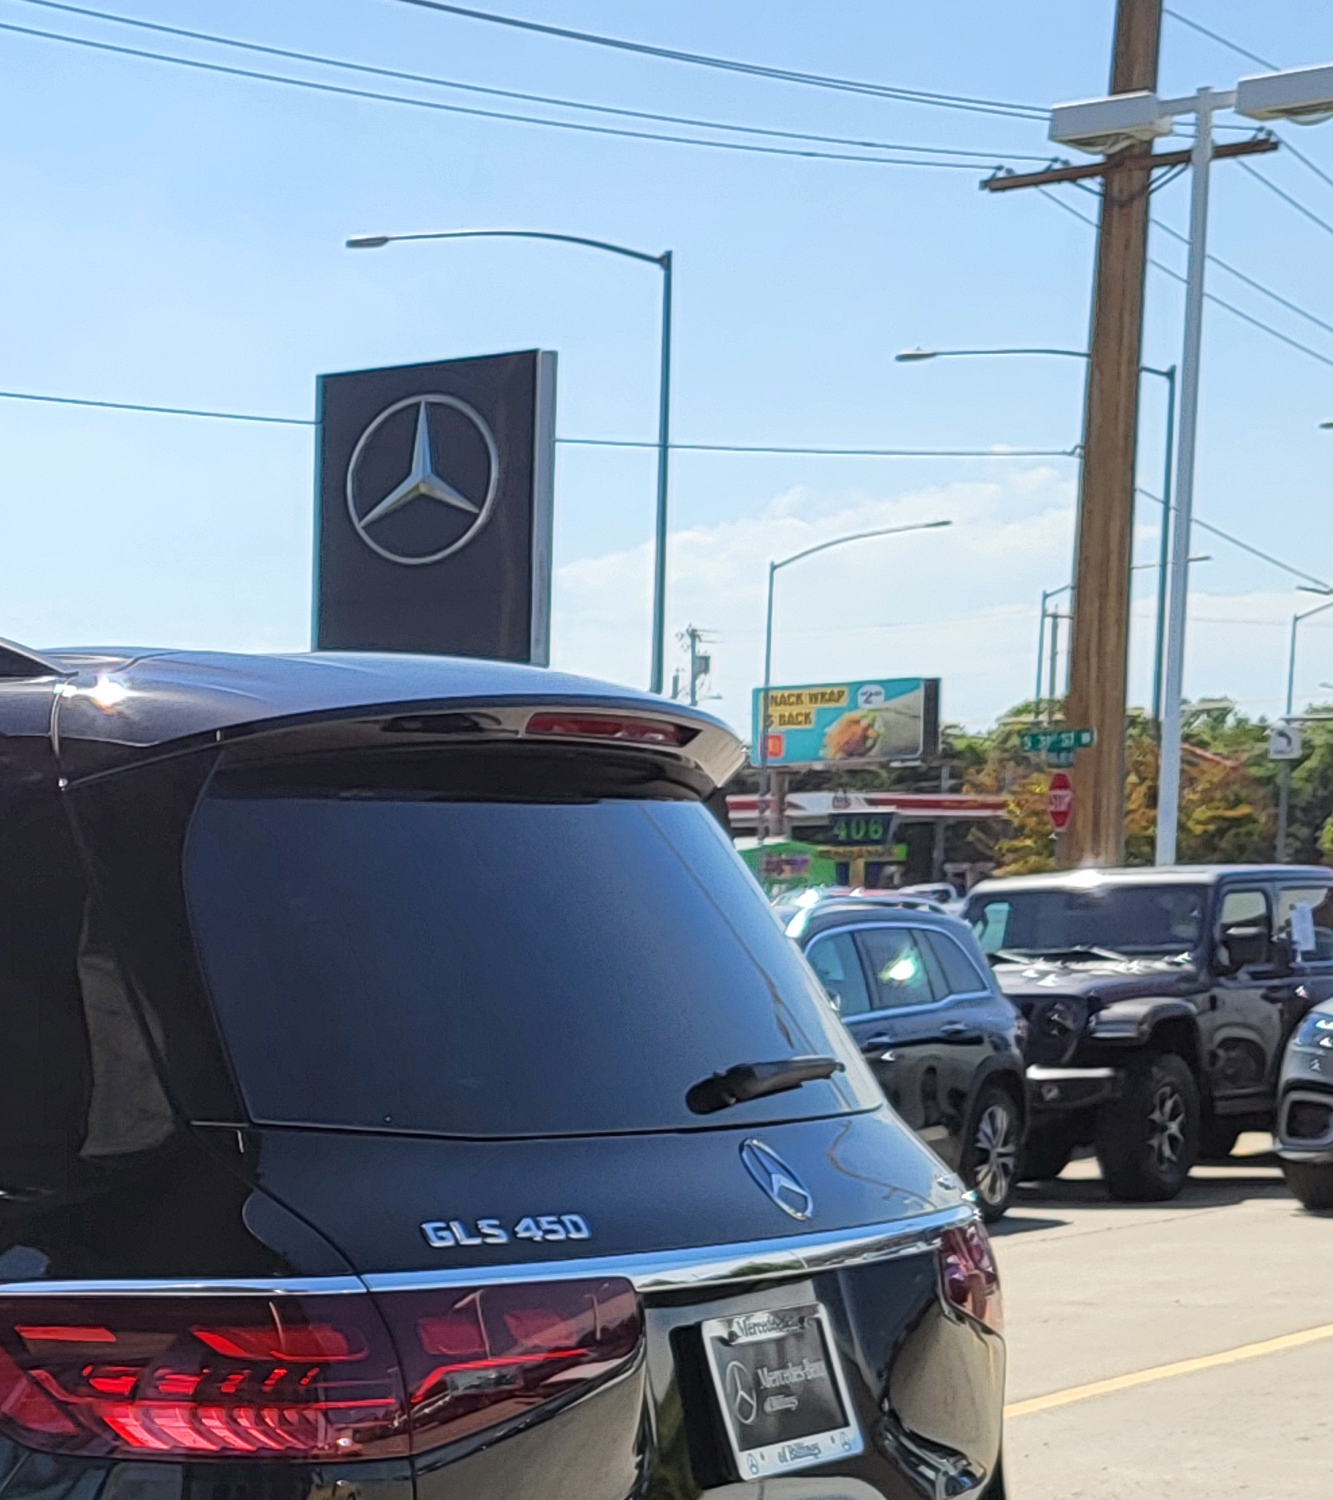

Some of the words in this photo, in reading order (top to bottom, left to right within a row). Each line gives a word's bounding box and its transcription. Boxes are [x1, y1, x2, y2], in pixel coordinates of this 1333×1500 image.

[764, 692, 804, 708] NACK
[808, 689, 846, 705] WRAP
[778, 711, 812, 727] BACK
[420, 1218, 510, 1248] GLS
[513, 1213, 592, 1243] 450
